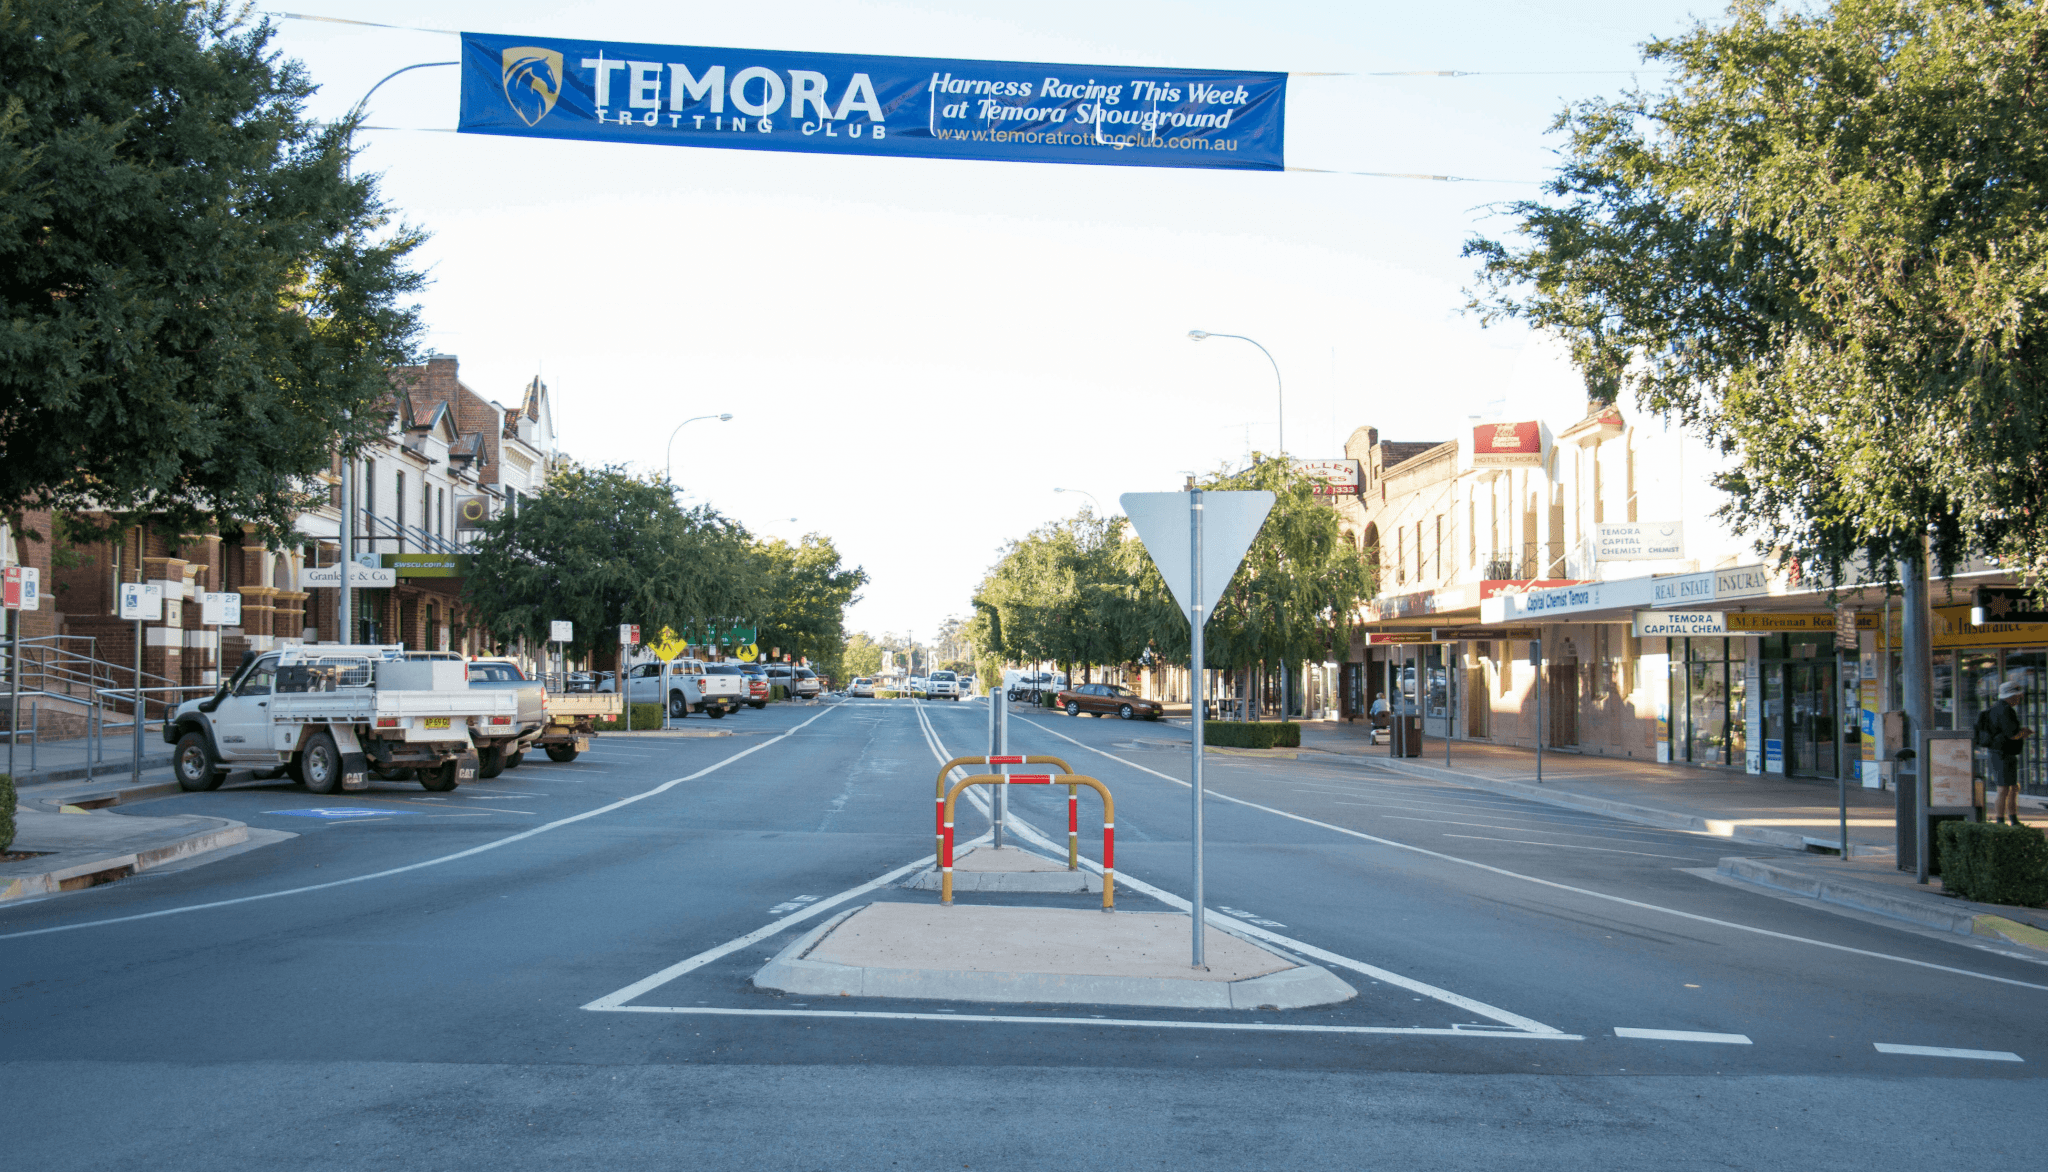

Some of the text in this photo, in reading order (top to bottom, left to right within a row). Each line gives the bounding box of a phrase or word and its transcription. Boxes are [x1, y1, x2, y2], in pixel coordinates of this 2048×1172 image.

[581, 57, 886, 123] TEMORA
[928, 72, 1249, 105] Harness Racing This Week
[595, 109, 886, 140] TROTTING CLUB
[942, 99, 1233, 130] at Temora Showground
[937, 127, 1238, 151] www.temoratrottingclub.com.au
[1601, 547, 1642, 555] CHEMIST
[358, 571, 368, 580] &
[371, 571, 389, 580] Co.
[1655, 579, 1710, 600] REAL ESTATE
[1527, 594, 1545, 612] Capital
[1546, 593, 1567, 608] Chemist
[1569, 590, 1589, 605] Temora
[1644, 625, 1688, 633] CAPITAL
[1668, 614, 1714, 623] TEMORA
[346, 773, 364, 784] CAT
[459, 768, 476, 779] CAT
